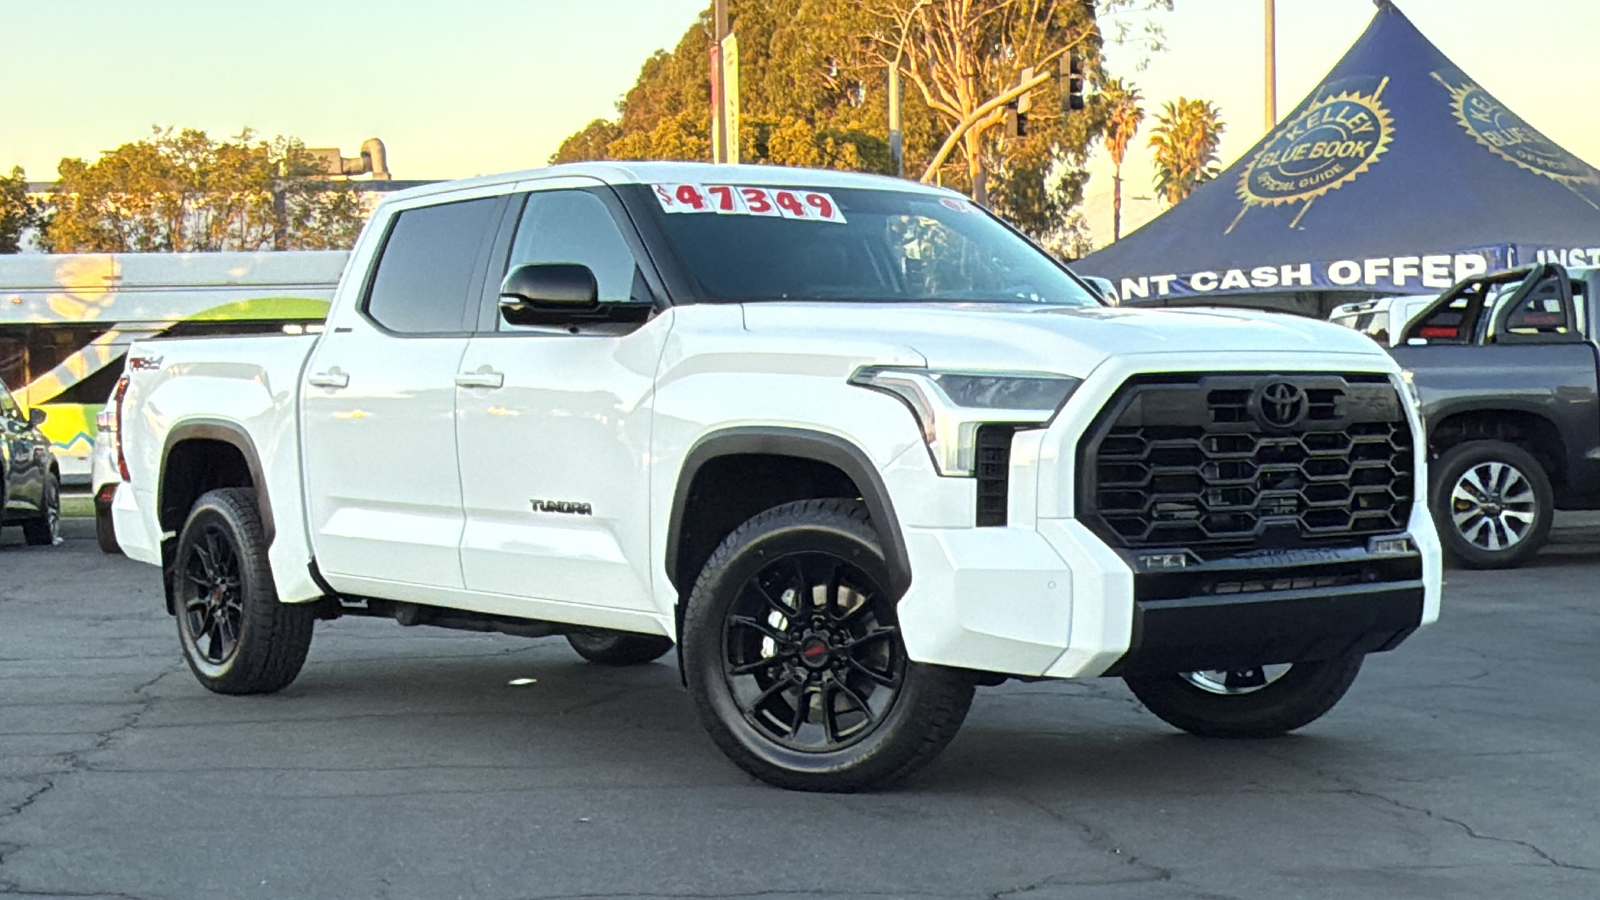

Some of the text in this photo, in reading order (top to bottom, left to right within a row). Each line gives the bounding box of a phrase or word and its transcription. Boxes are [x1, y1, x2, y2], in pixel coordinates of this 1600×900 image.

[1286, 106, 1375, 141] KELLEY
[1257, 140, 1372, 169] BLUE BOOK
[1299, 163, 1345, 187] GUIDE
[1190, 263, 1312, 292] CASH
[1328, 253, 1487, 288] OFFER
[529, 498, 592, 516] TUNDRA
